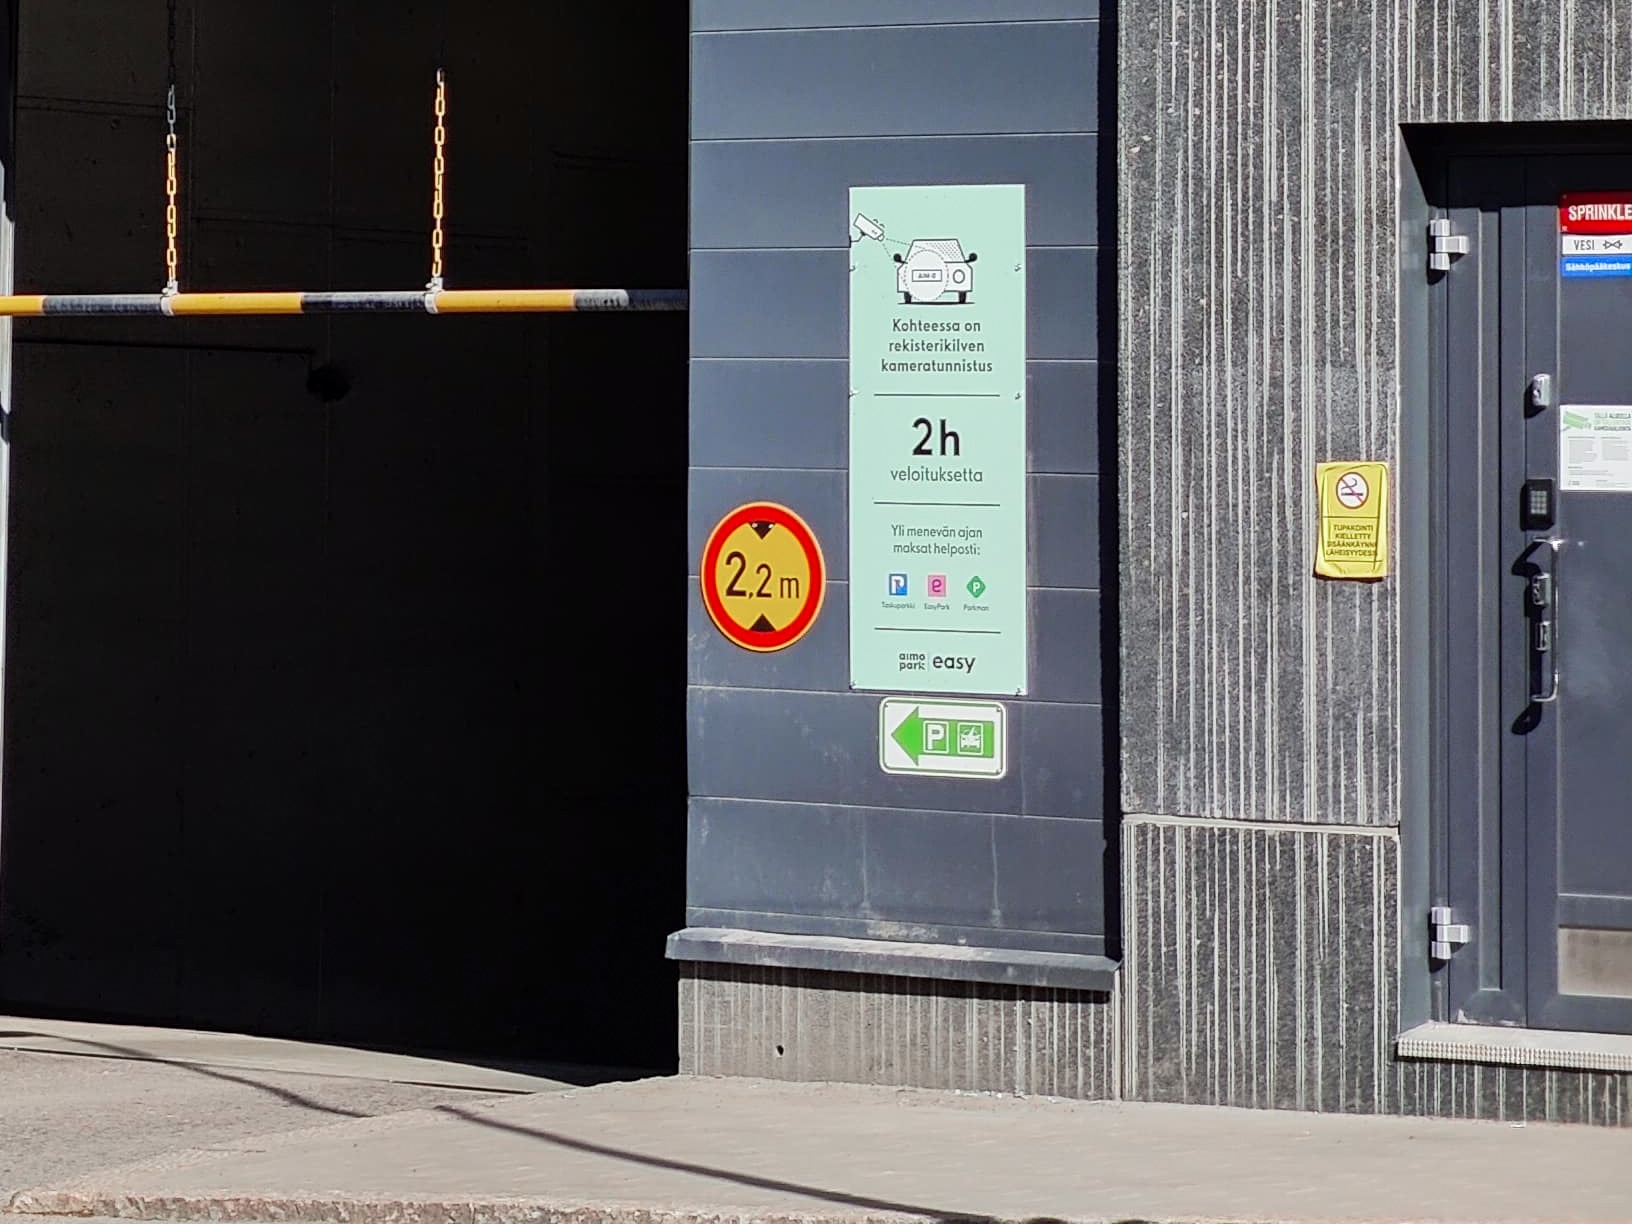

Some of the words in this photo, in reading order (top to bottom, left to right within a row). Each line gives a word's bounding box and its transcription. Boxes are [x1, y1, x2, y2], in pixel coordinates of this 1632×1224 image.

[1573, 239, 1595, 251] VESI
[892, 318, 960, 333] Kohteessa
[964, 322, 981, 333] on
[889, 339, 985, 353] rekisterikilven
[881, 359, 993, 373] kameratunnistus
[890, 466, 984, 483] veloituksetta
[891, 524, 905, 537] Yli
[907, 526, 956, 537] menevän
[958, 526, 983, 541] ajan
[893, 542, 932, 554] maksat
[934, 542, 981, 557] helposti:
[725, 551, 772, 599] 2,2
[780, 577, 800, 599] m
[898, 660, 926, 672] park
[932, 655, 976, 674] easy
